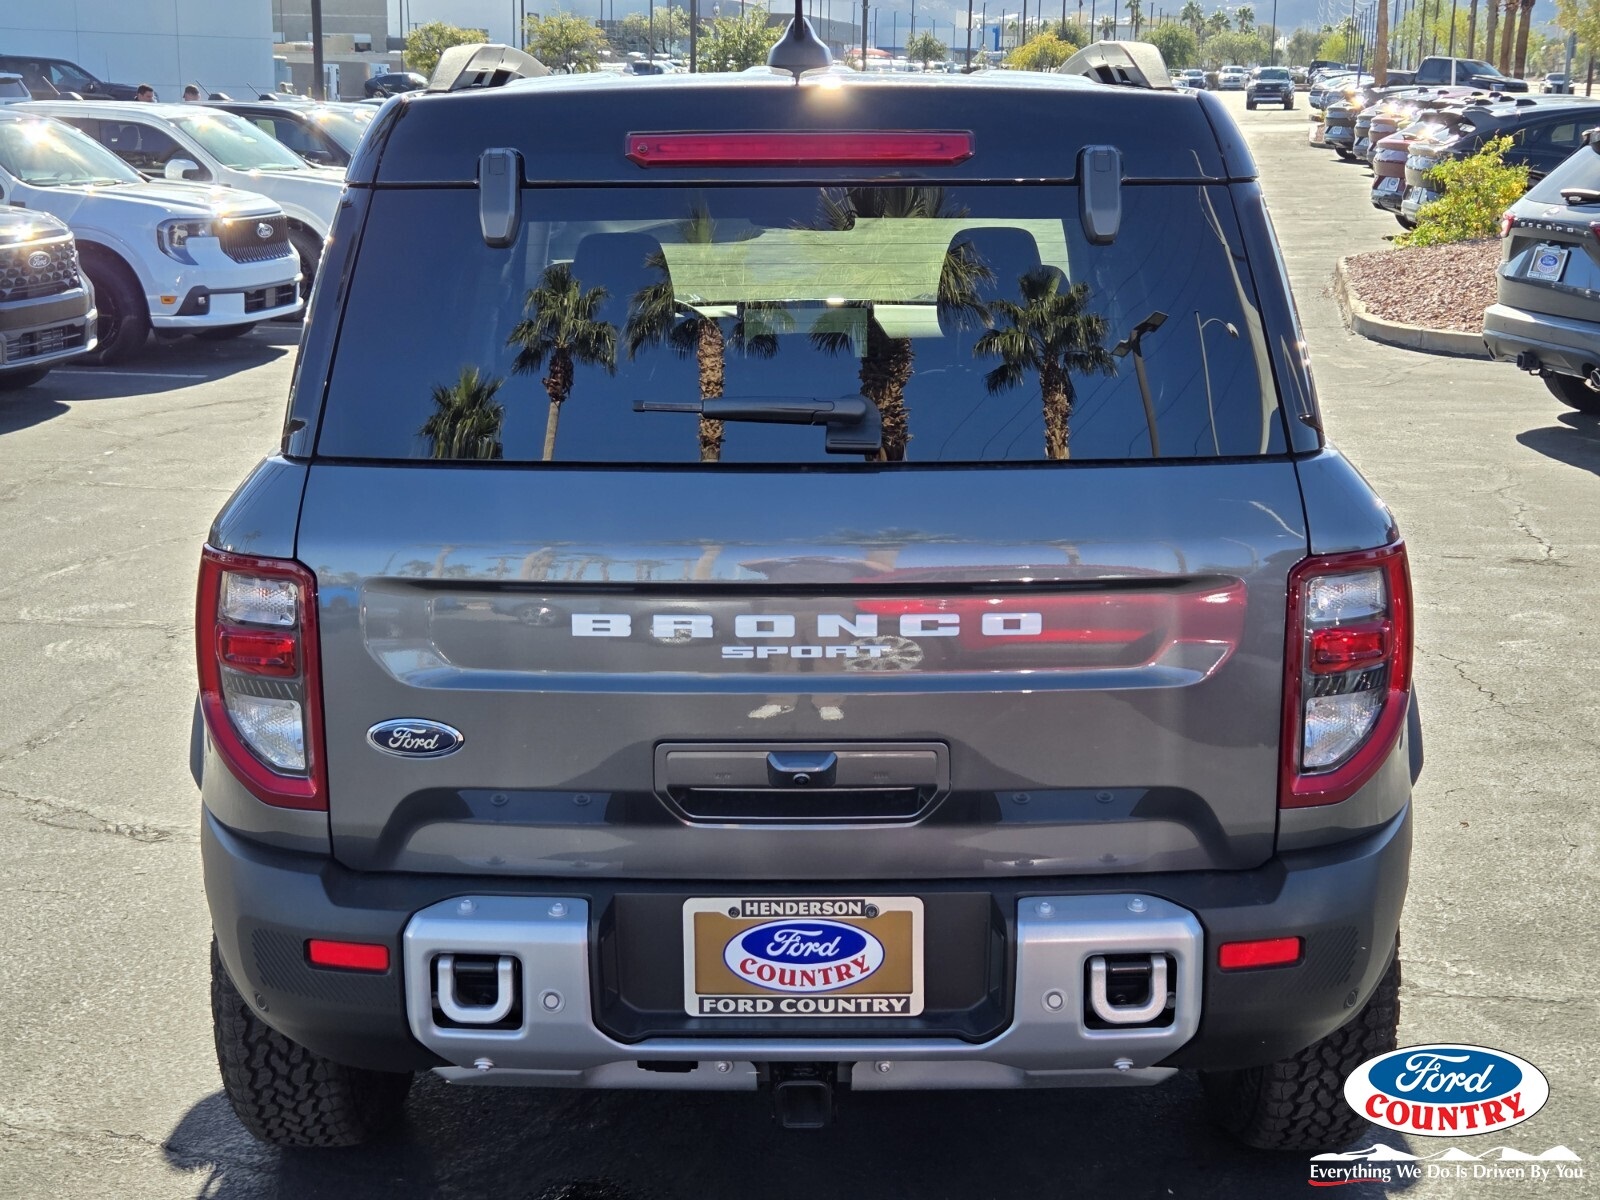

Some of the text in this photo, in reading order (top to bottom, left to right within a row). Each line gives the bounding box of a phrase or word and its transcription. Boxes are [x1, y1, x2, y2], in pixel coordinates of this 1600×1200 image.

[571, 612, 1043, 638] BRONCO
[721, 645, 892, 659] SPORT
[388, 726, 440, 750] Ford
[745, 901, 863, 916] HENDERSON
[766, 929, 842, 957] Ford
[739, 954, 871, 987] COUNTRY
[702, 998, 908, 1013] FORD COUNTRY
